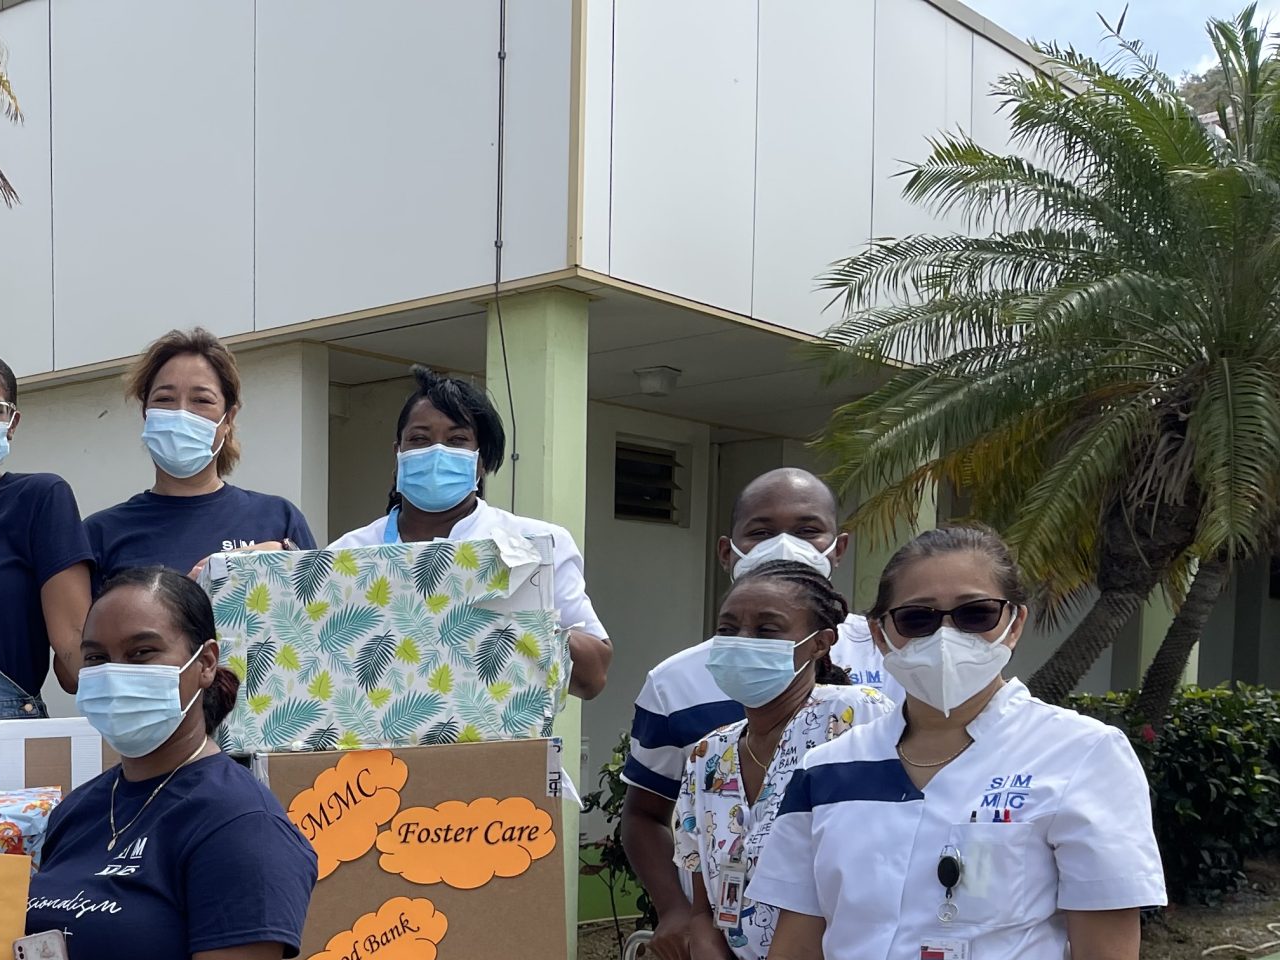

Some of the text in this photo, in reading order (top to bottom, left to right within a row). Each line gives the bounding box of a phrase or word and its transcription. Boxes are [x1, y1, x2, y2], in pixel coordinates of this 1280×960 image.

[778, 756, 798, 770] BAM
[294, 768, 380, 841] MMC
[397, 820, 540, 845] Foster Care
[363, 912, 420, 955] Bank
